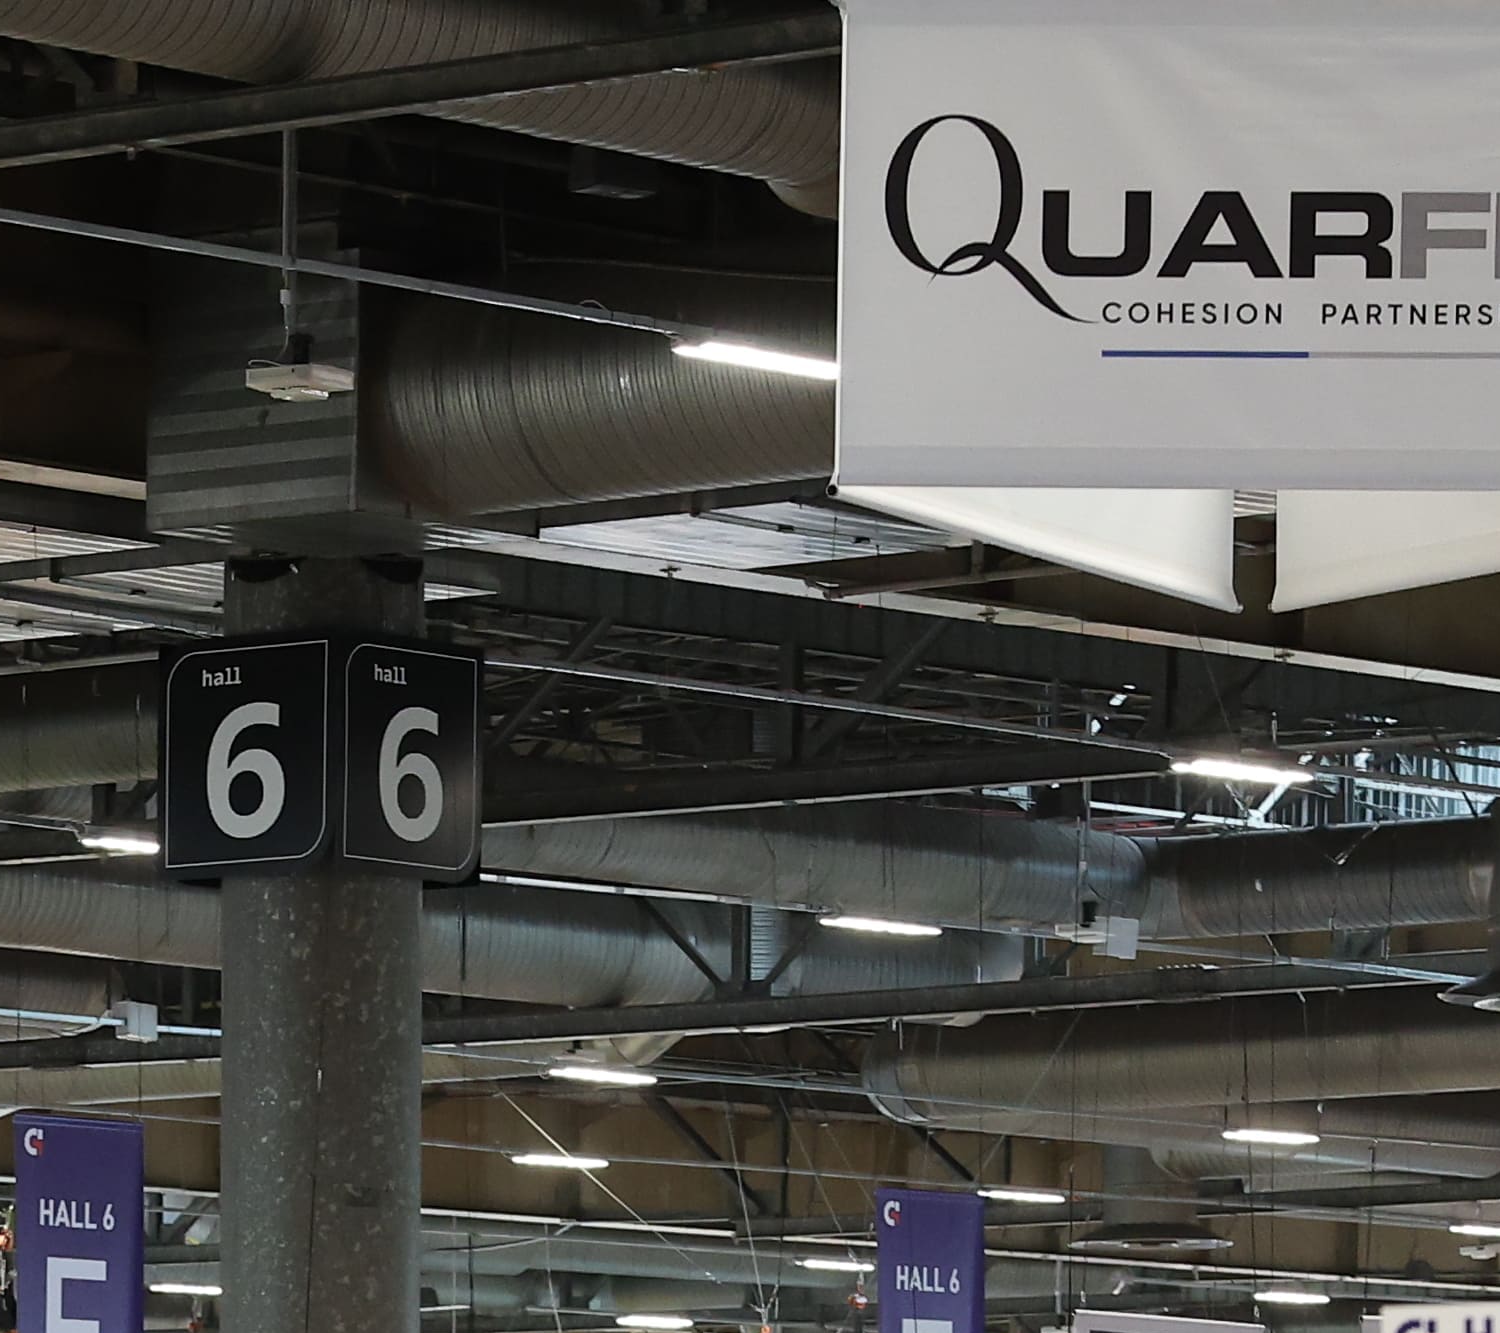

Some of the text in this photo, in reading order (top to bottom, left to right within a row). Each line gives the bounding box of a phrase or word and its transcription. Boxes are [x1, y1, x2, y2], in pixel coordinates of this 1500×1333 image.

[1102, 303, 1283, 324] COHESION
[202, 667, 242, 687] hall
[374, 664, 407, 685] hall
[207, 702, 285, 838] 6
[379, 707, 443, 842] 6
[39, 1199, 115, 1231] HALL 6
[896, 1265, 960, 1293] HALL 6
